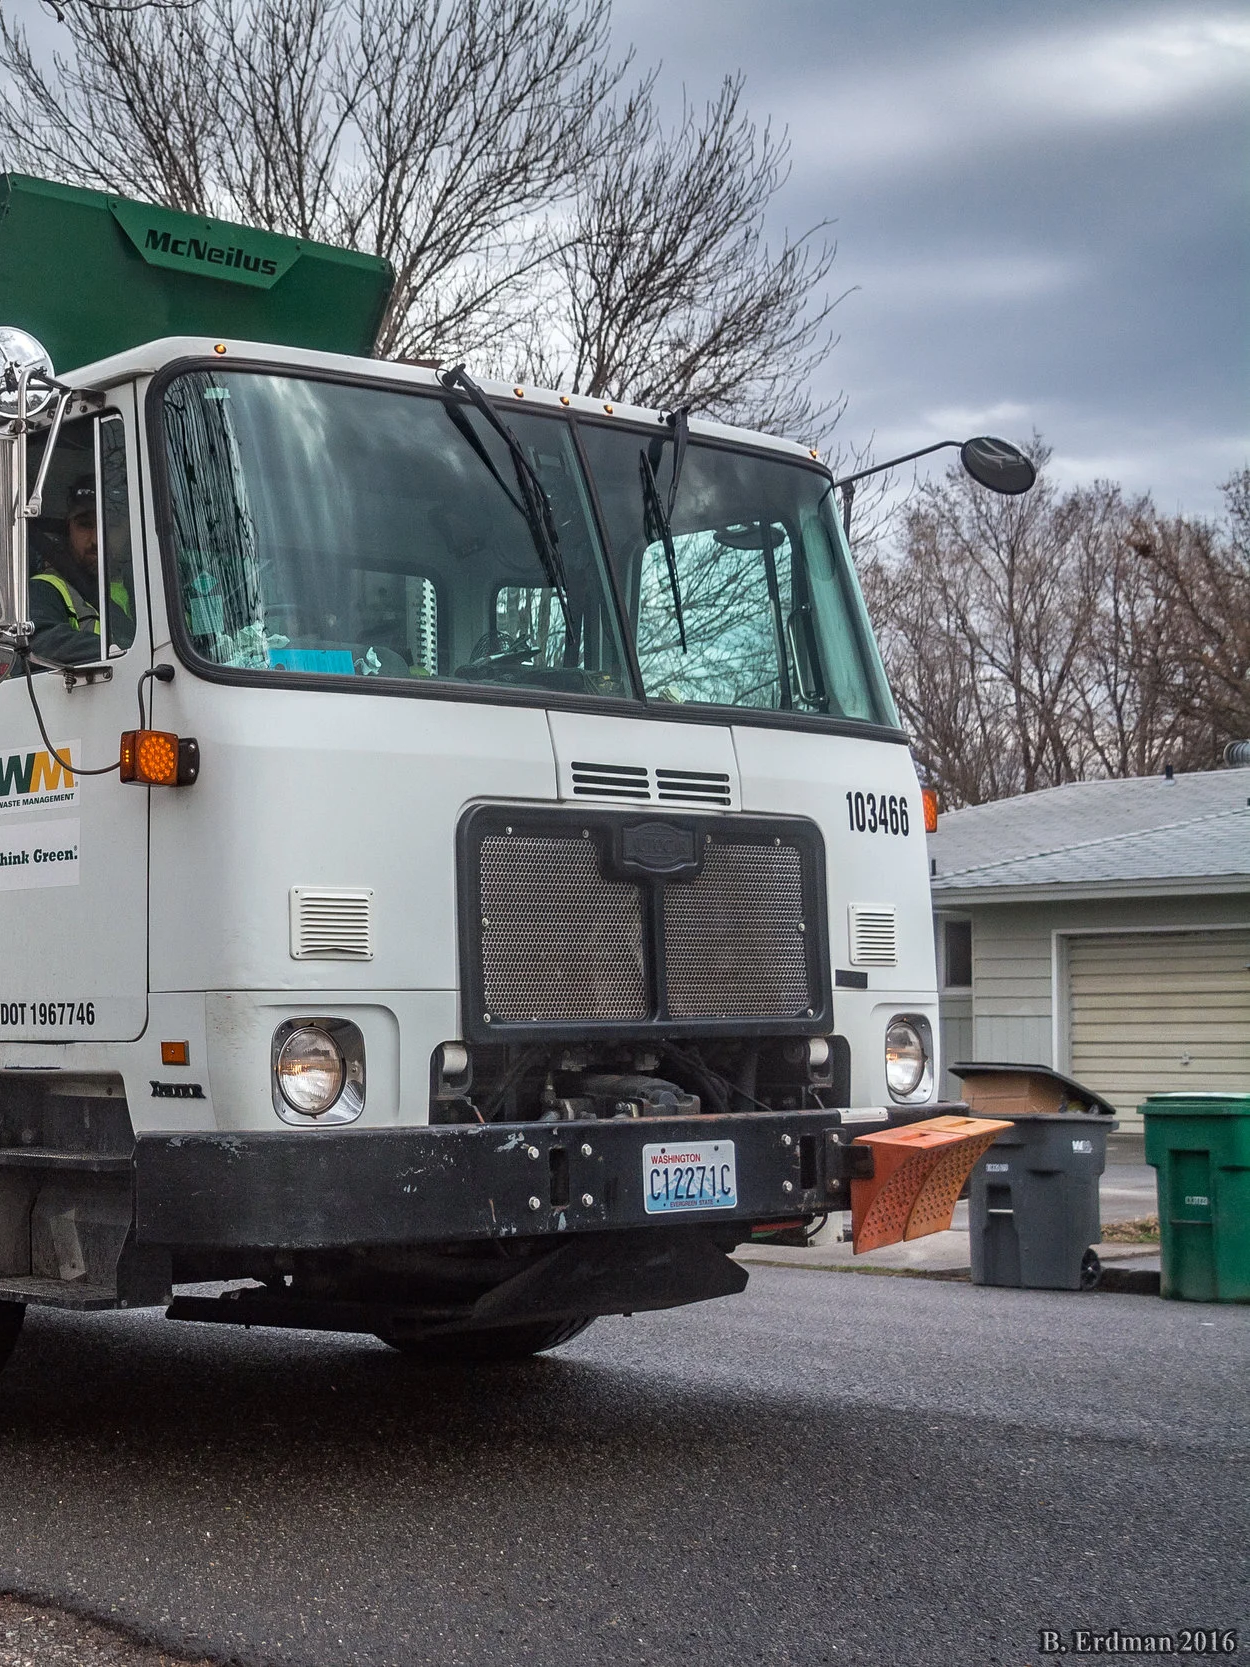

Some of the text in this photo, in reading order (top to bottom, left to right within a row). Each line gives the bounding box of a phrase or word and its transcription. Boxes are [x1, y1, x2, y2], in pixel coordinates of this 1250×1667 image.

[145, 229, 278, 277] McNeilus
[22, 792, 75, 806] MANAGEMENT
[845, 791, 910, 837] 103466
[30, 1002, 96, 1026] 1967746
[651, 1153, 701, 1164] WASHINGTON
[650, 1164, 731, 1201] C12271C
[669, 1200, 698, 1208] EVERGREEN
